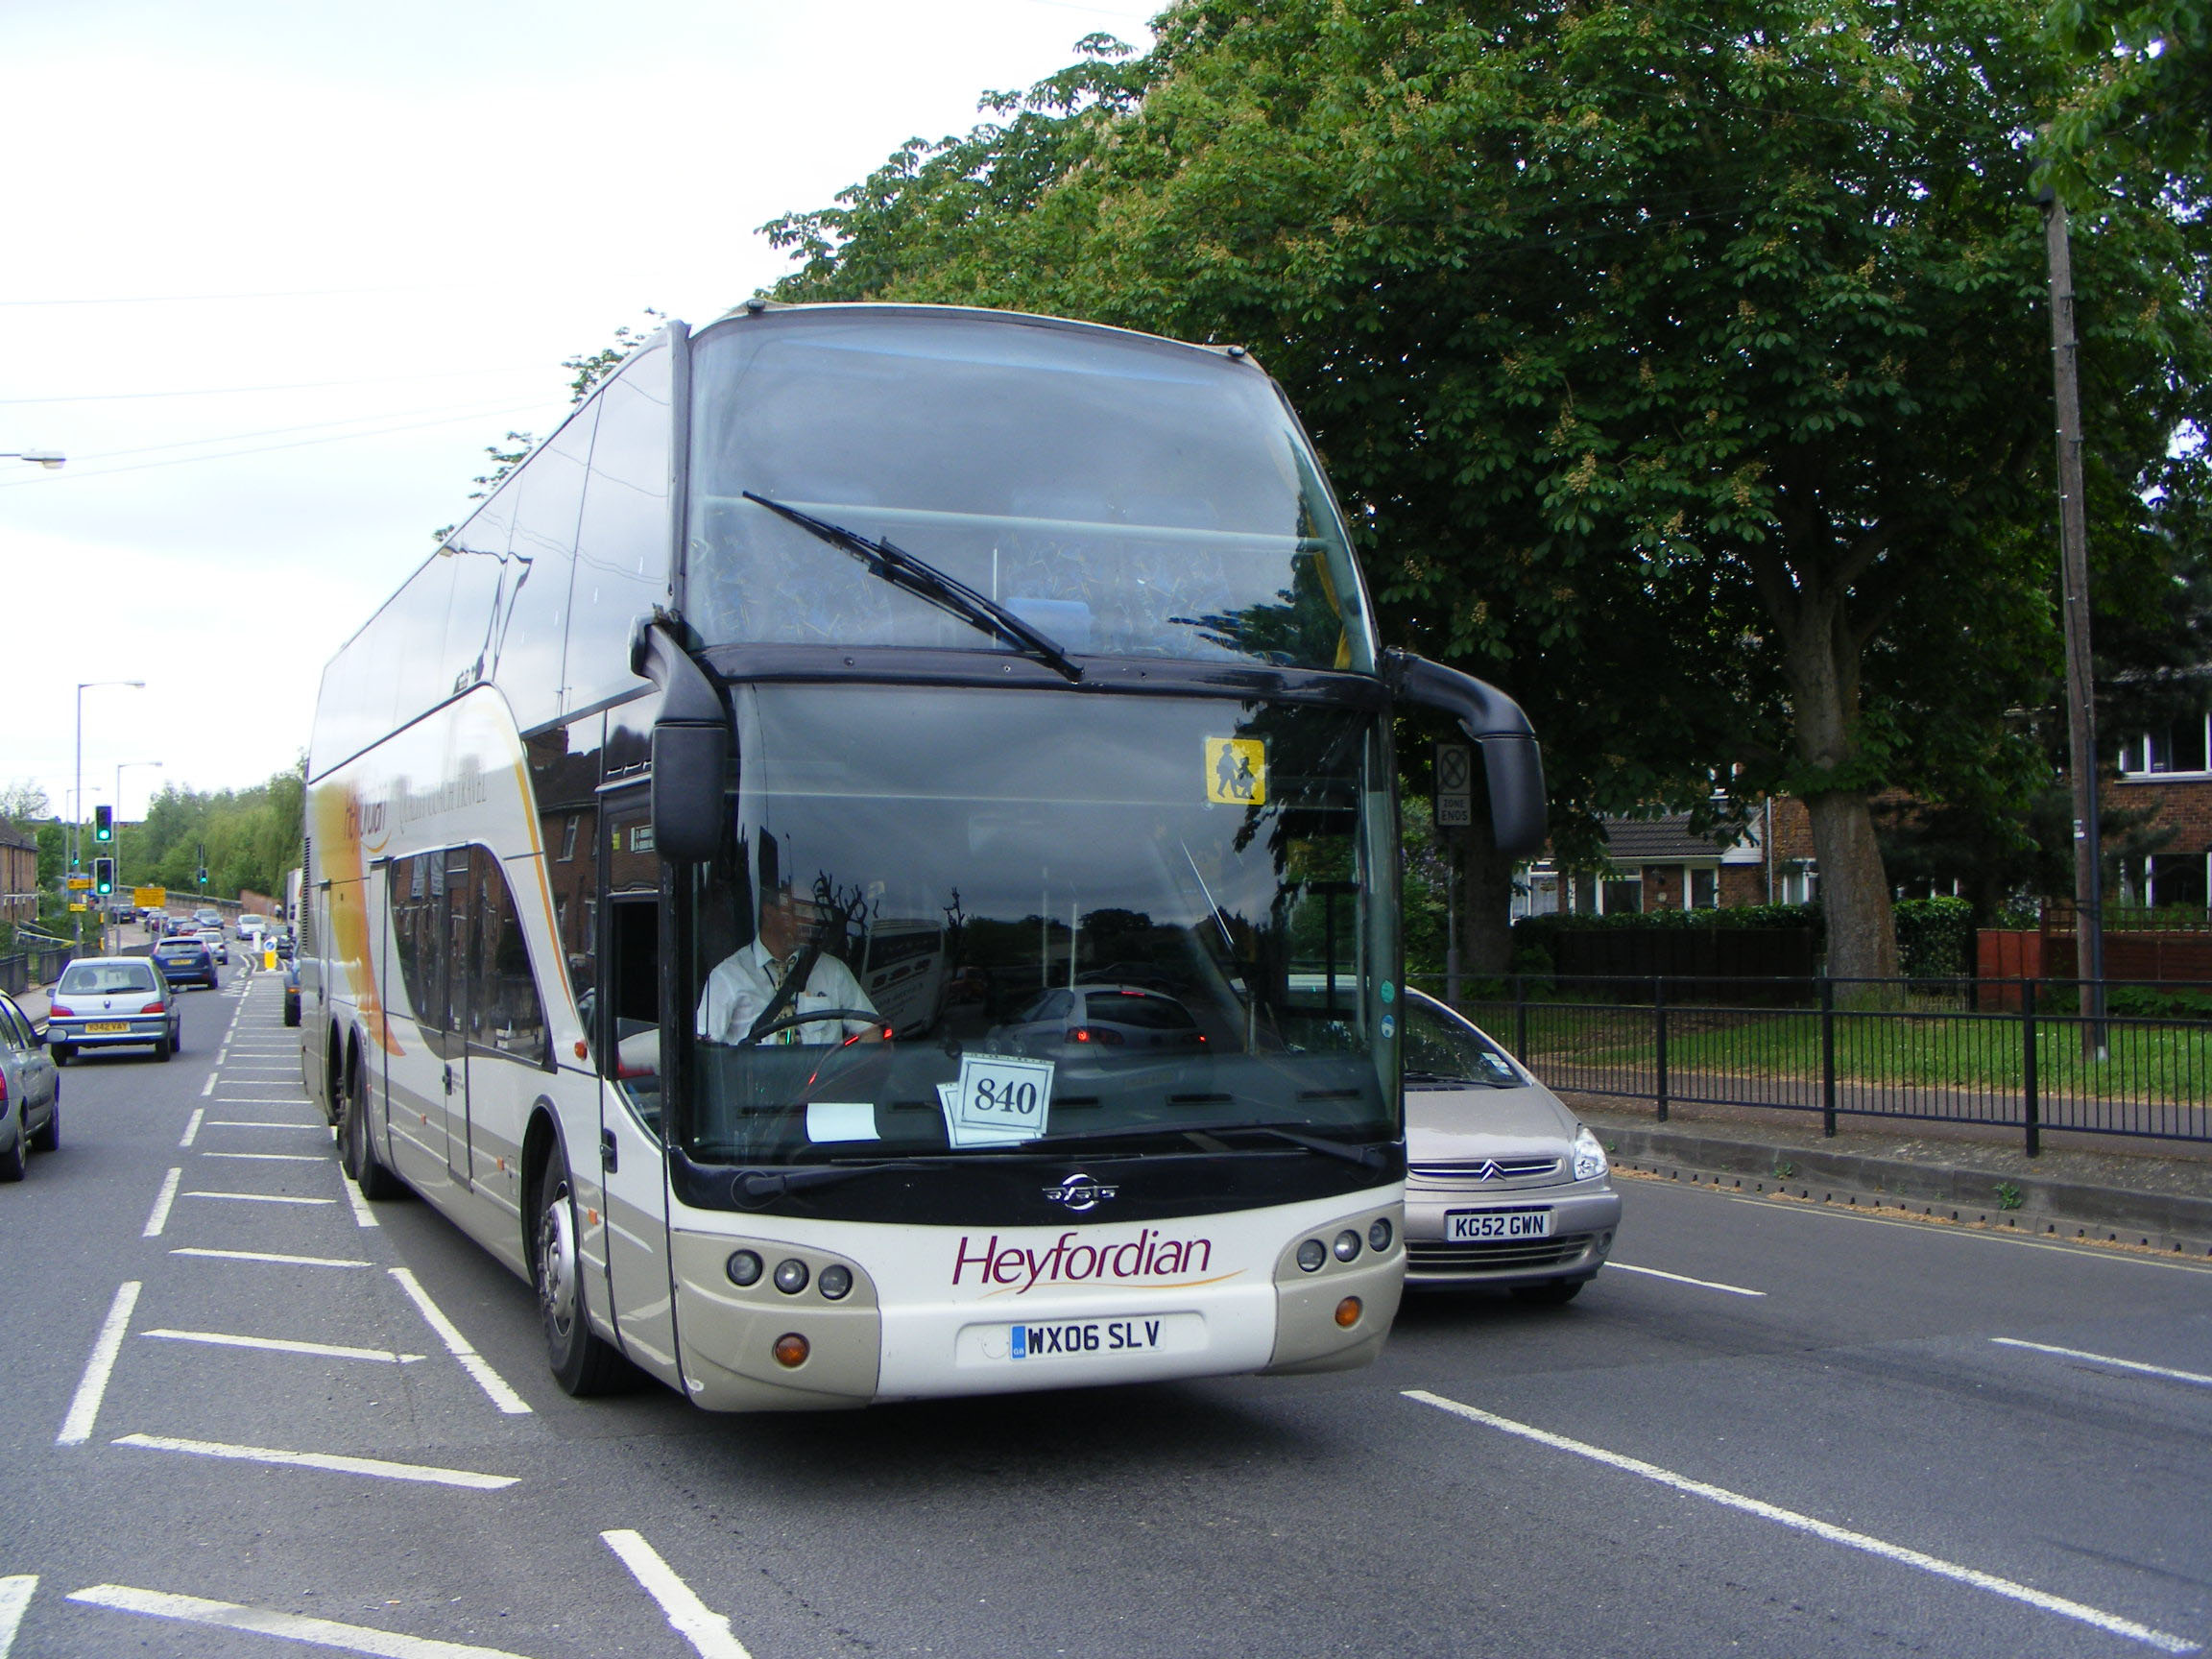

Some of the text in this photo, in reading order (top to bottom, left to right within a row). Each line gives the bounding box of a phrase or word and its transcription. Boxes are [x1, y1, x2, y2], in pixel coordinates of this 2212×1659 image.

[1441, 809, 1468, 823] ENDS
[1443, 799, 1465, 808] ZONE
[974, 1078, 1037, 1115] 840
[1455, 1214, 1544, 1238] KG52 GWN
[951, 1228, 1212, 1295] Heyfordian
[1027, 1325, 1099, 1355] WX06
[1108, 1320, 1160, 1349] SLV
